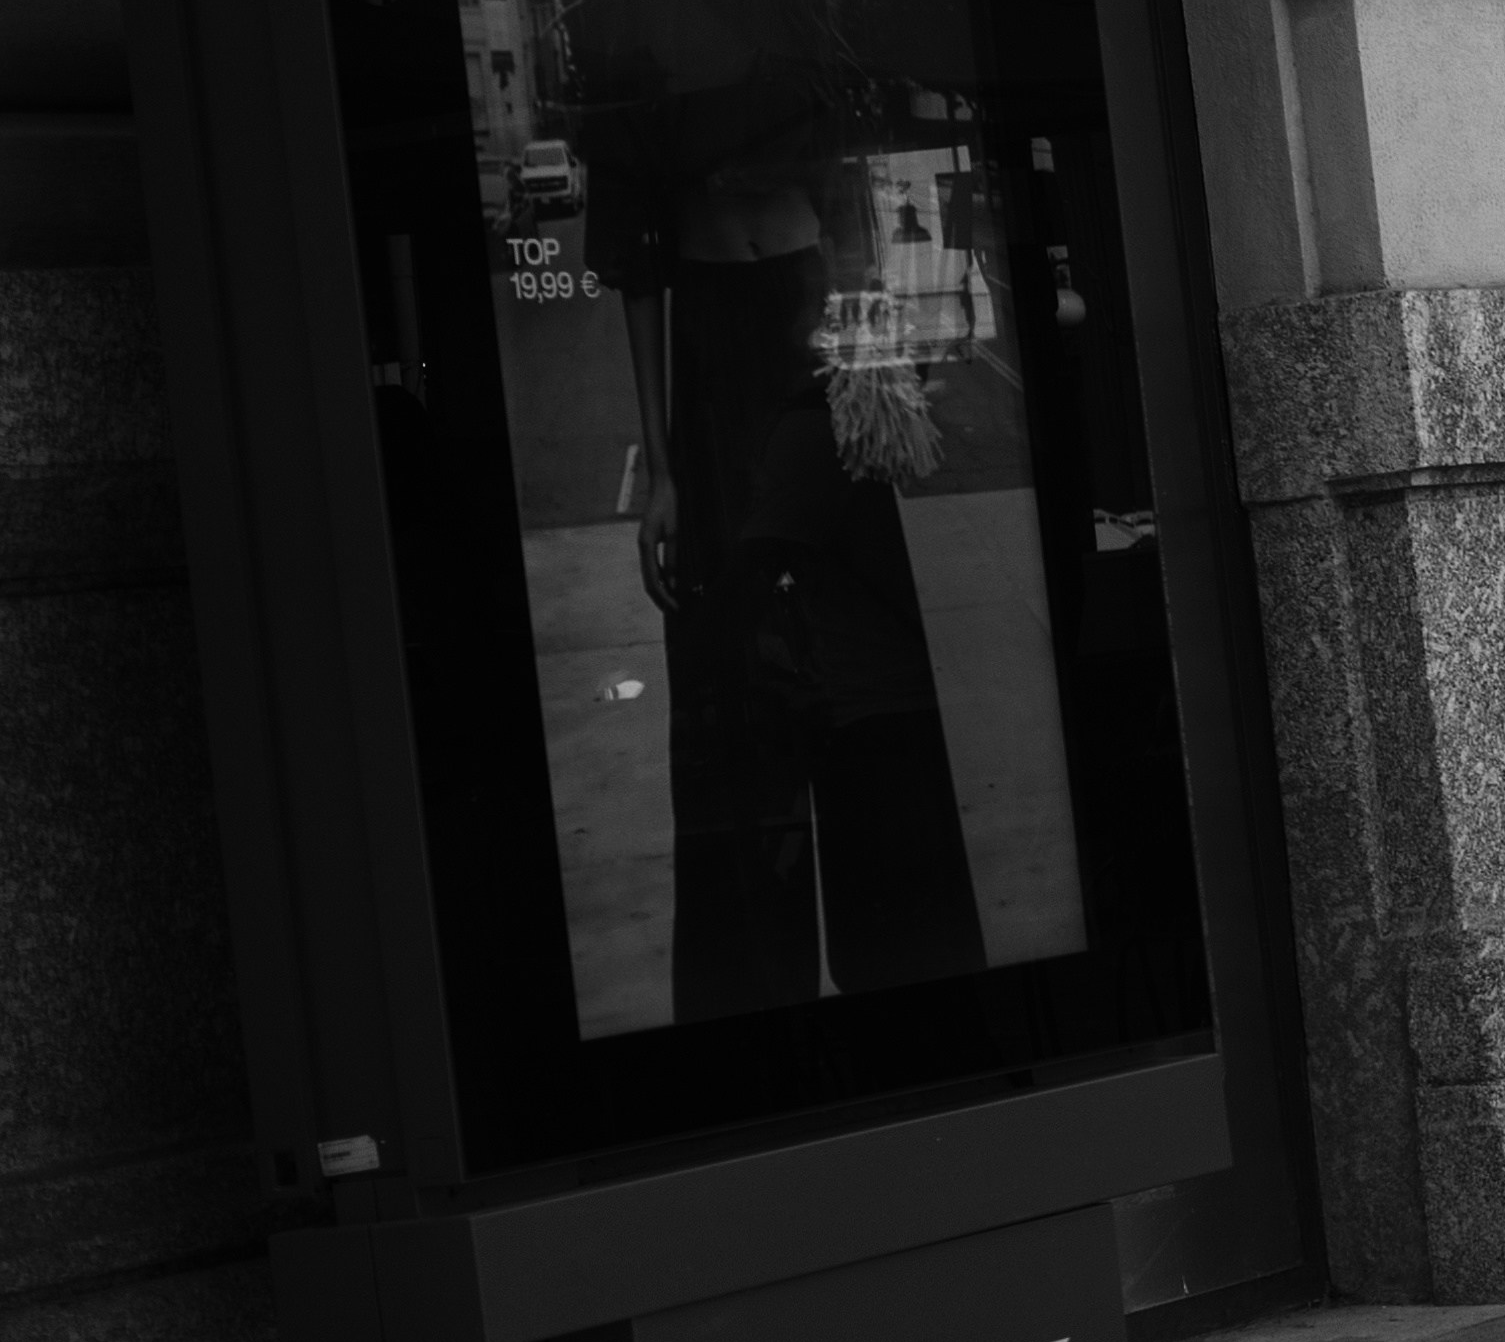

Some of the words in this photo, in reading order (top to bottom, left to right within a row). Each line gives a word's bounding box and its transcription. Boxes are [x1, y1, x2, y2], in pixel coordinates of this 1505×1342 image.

[506, 237, 561, 266] TOP
[509, 270, 575, 304] 19,99
[579, 270, 601, 298] €
